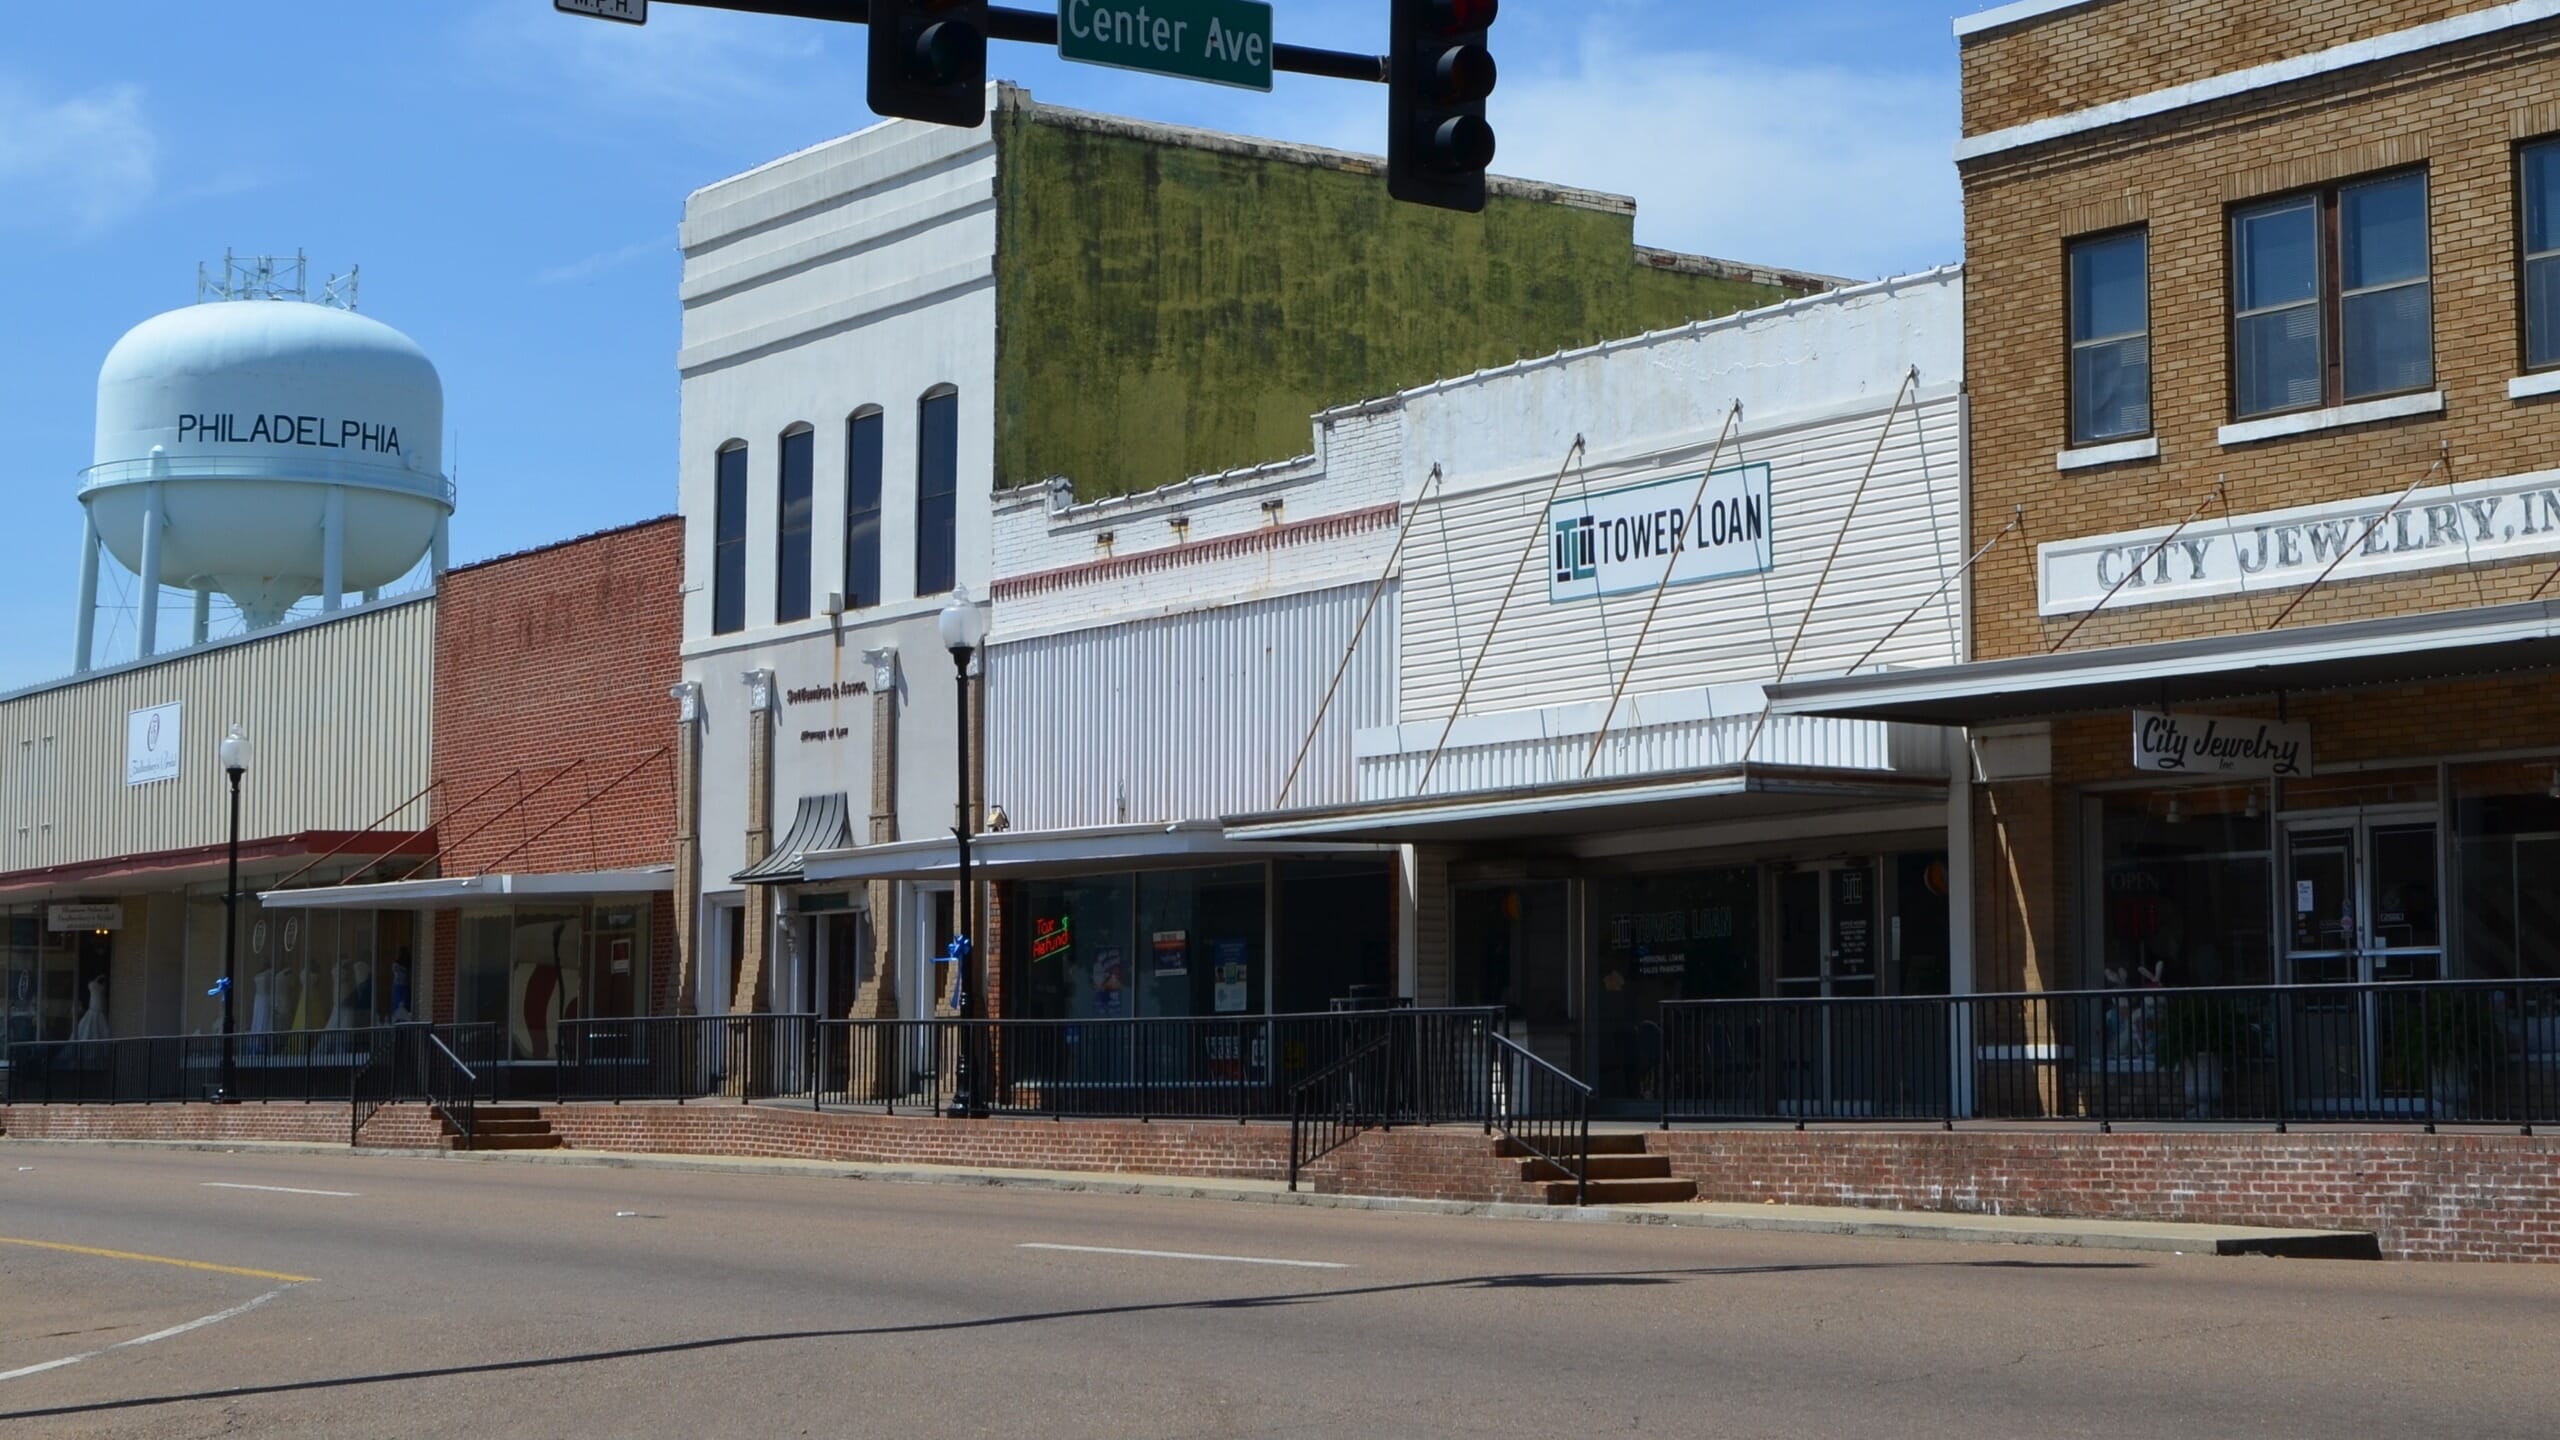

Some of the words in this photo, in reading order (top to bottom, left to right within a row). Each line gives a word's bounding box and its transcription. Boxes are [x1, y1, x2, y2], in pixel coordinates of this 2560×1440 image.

[1069, 0, 1187, 52] Center
[1204, 17, 1263, 66] Ave
[178, 414, 401, 456] PHILADELPHIA
[1599, 508, 1685, 565] TOWER
[1696, 494, 1762, 549] LOAN
[2097, 538, 2215, 592] CITY
[2142, 716, 2188, 769] City
[2194, 720, 2300, 776] Jewelry
[1032, 931, 1069, 958] Refund
[1036, 917, 1055, 935] Tax
